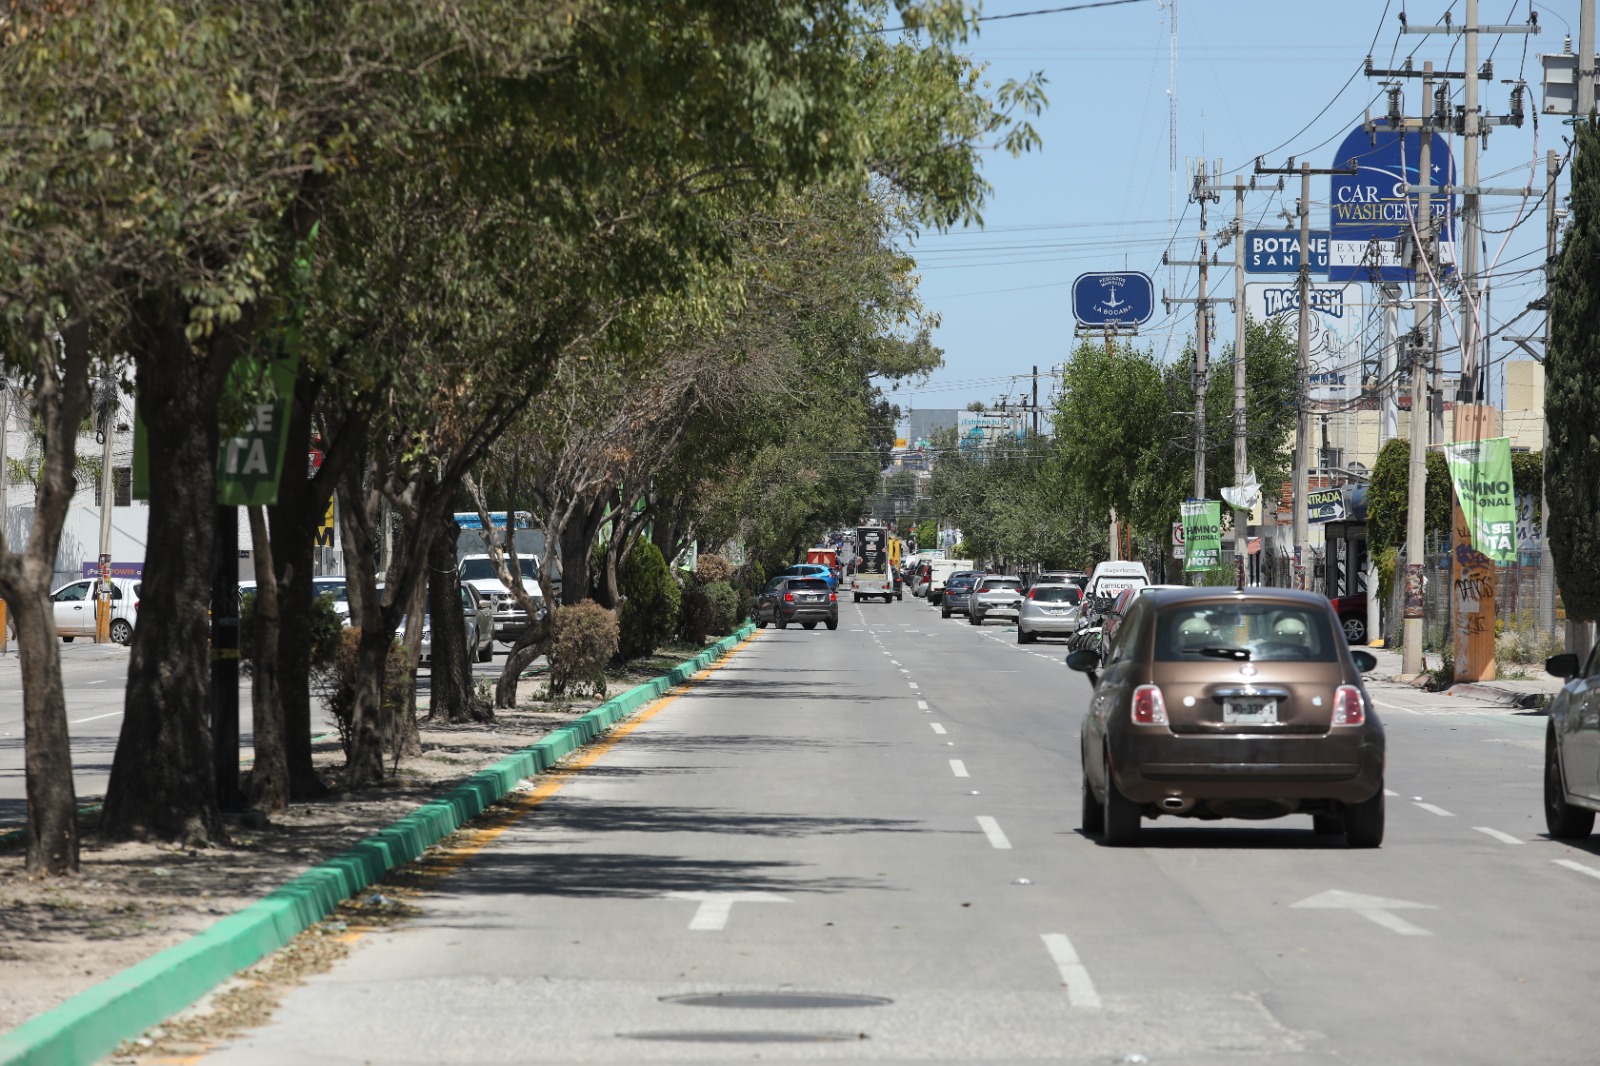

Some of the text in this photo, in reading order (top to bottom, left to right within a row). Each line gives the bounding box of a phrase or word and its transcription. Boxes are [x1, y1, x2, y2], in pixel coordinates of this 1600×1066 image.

[1338, 184, 1380, 203] CAR
[1336, 203, 1446, 220] WASHCENER
[1253, 238, 1328, 252] BOTANE
[1254, 255, 1294, 266] SAN
[1338, 254, 1346, 264] Y
[1093, 304, 1102, 313] LA
[1458, 479, 1510, 496] HIMNO
[1308, 490, 1342, 505] NTRADA
[1491, 523, 1511, 534] SE
